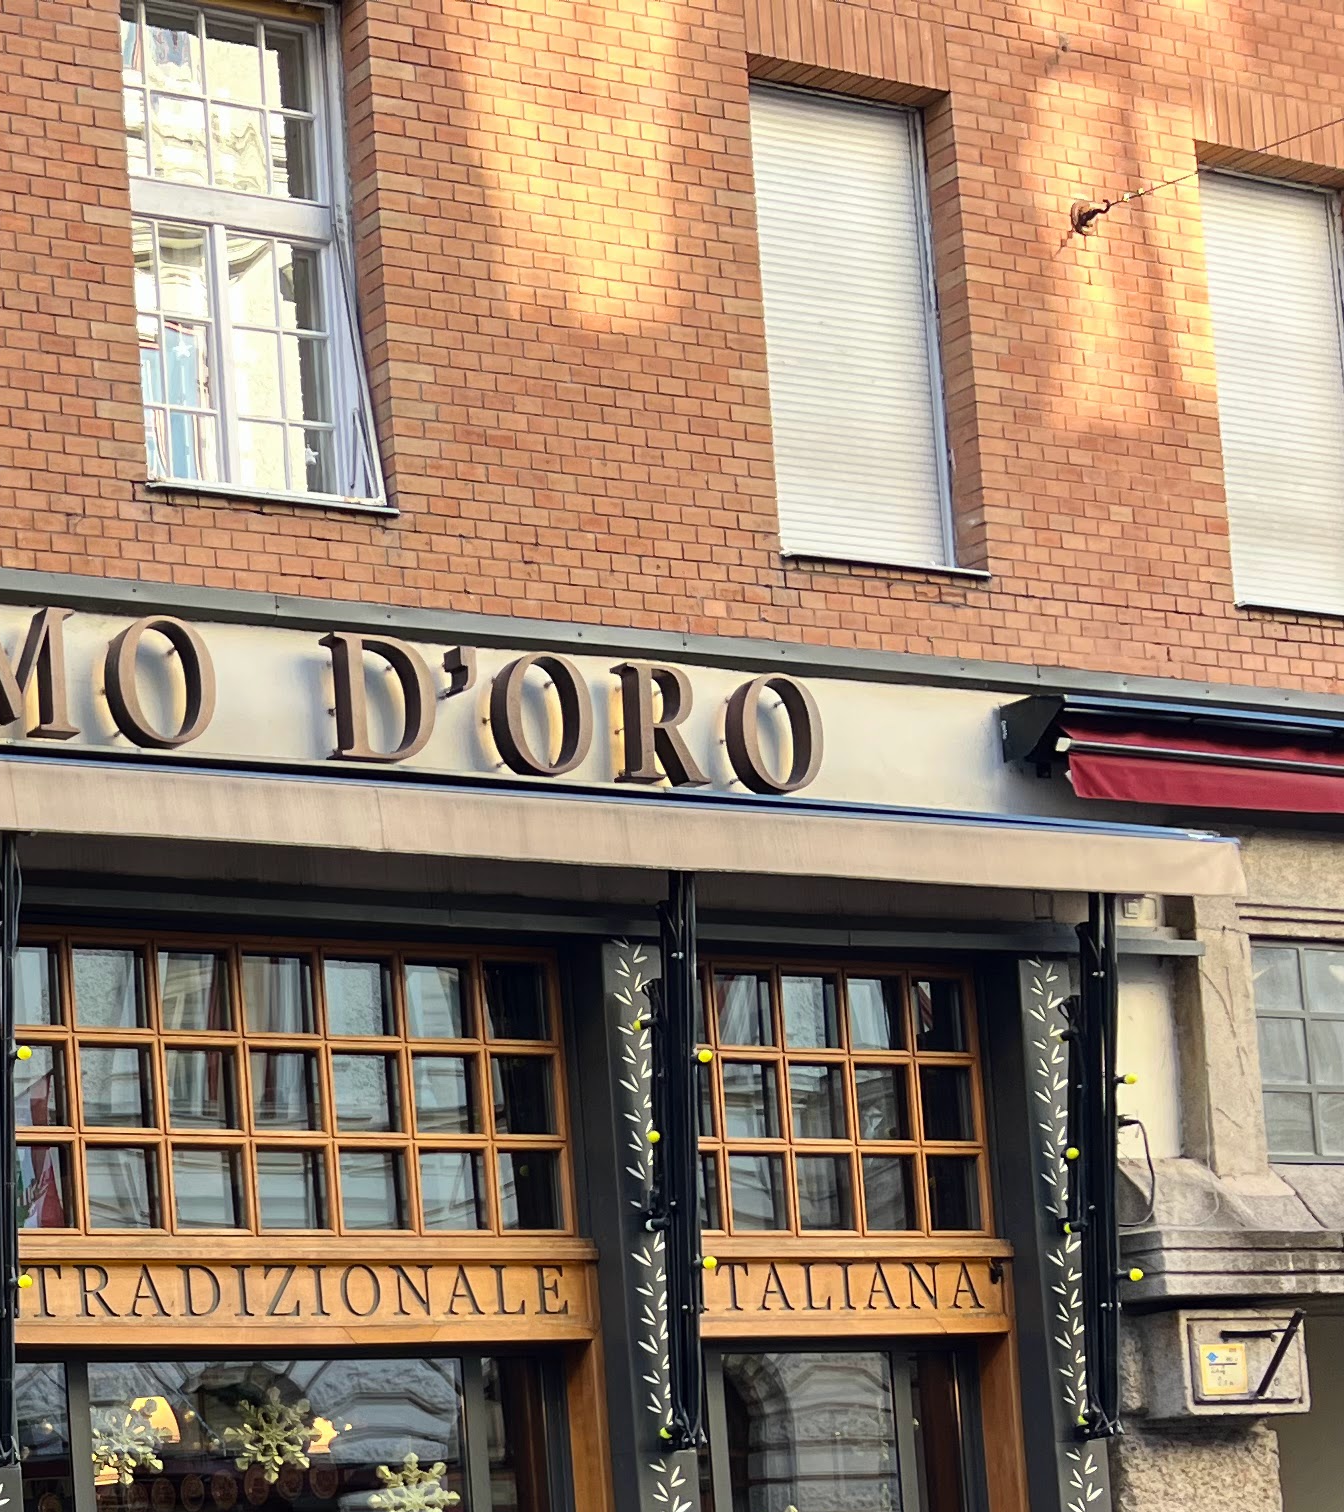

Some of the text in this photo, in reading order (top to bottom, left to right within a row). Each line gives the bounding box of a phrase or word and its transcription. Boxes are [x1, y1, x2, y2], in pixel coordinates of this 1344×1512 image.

[316, 629, 825, 795] D'ORO
[20, 1263, 570, 1319] TRADIZIONALE
[704, 1260, 986, 1312] TALIANA
